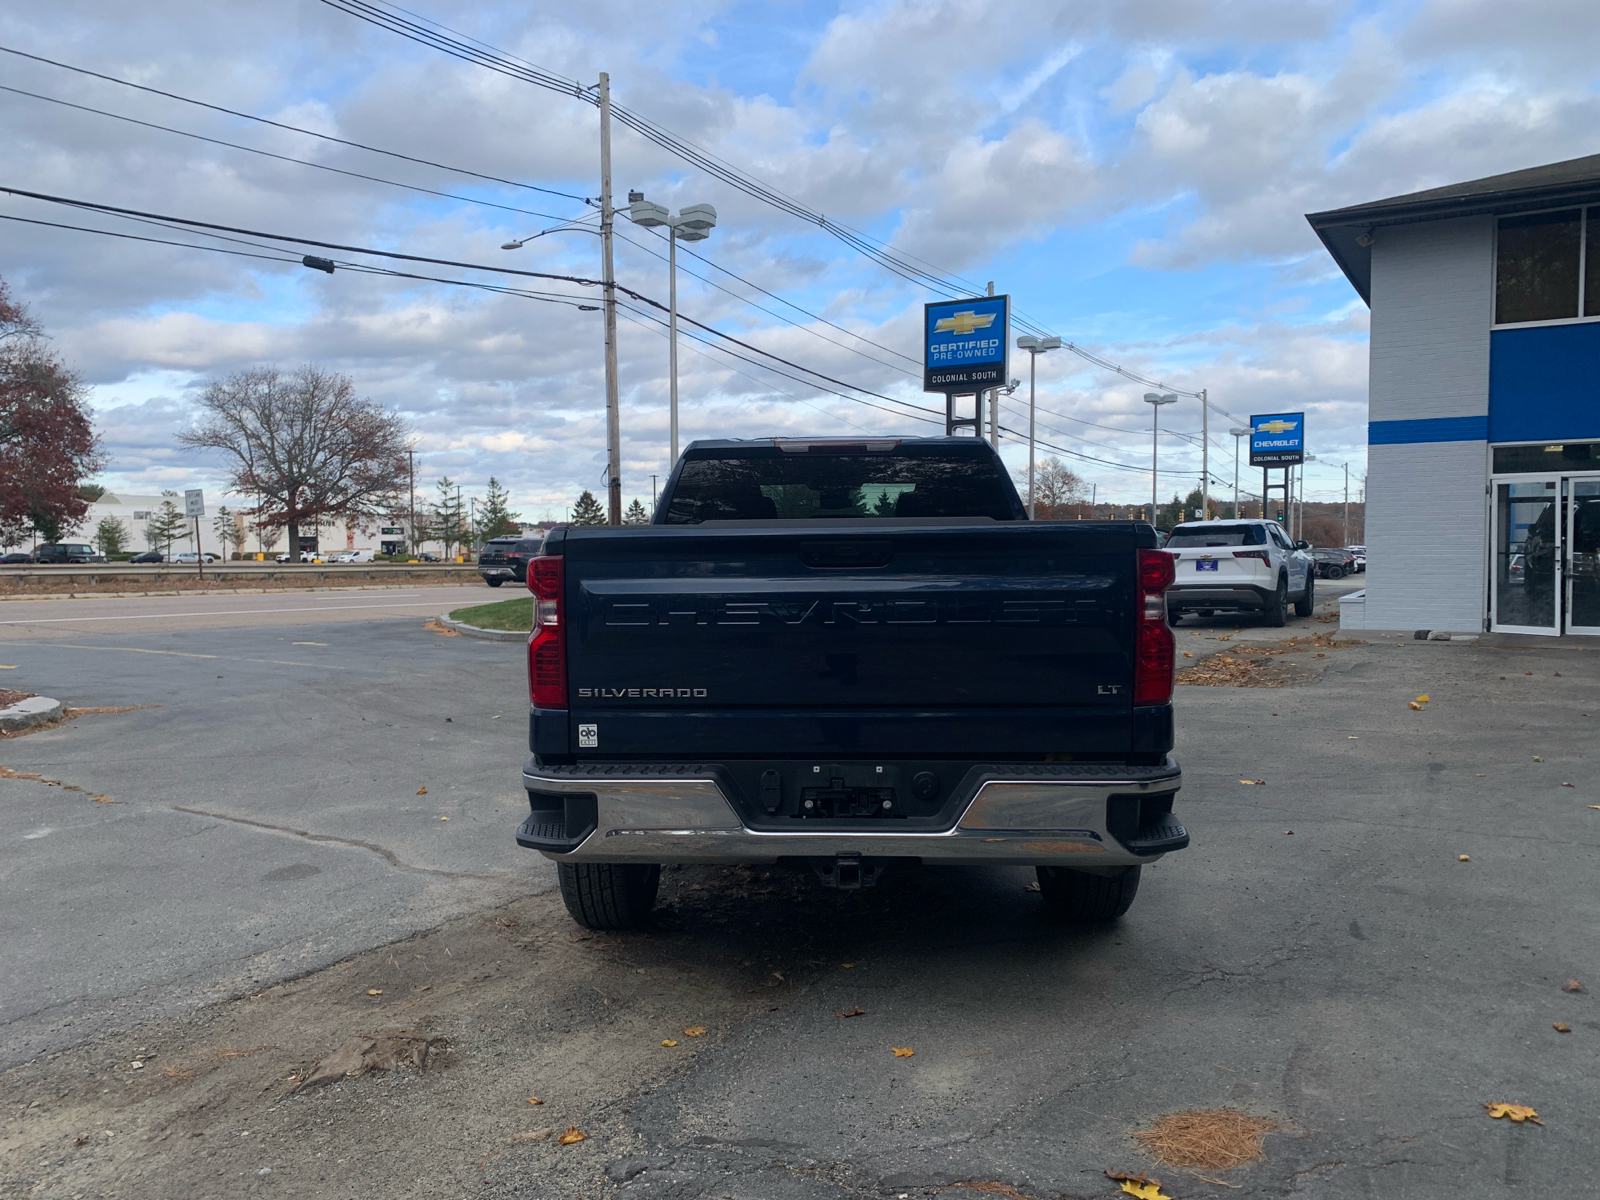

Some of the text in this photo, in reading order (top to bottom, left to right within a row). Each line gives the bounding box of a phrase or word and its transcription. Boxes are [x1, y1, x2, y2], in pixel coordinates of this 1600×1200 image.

[930, 339, 998, 352] CERTIFIED
[934, 348, 995, 360] PRE-OWNED
[932, 371, 997, 383] COLONIAL SOUTH
[1254, 439, 1299, 447] CHEVROLET
[604, 600, 1098, 625] CHEVROLET
[578, 688, 708, 698] SILVERADO
[1097, 685, 1122, 695] LT
